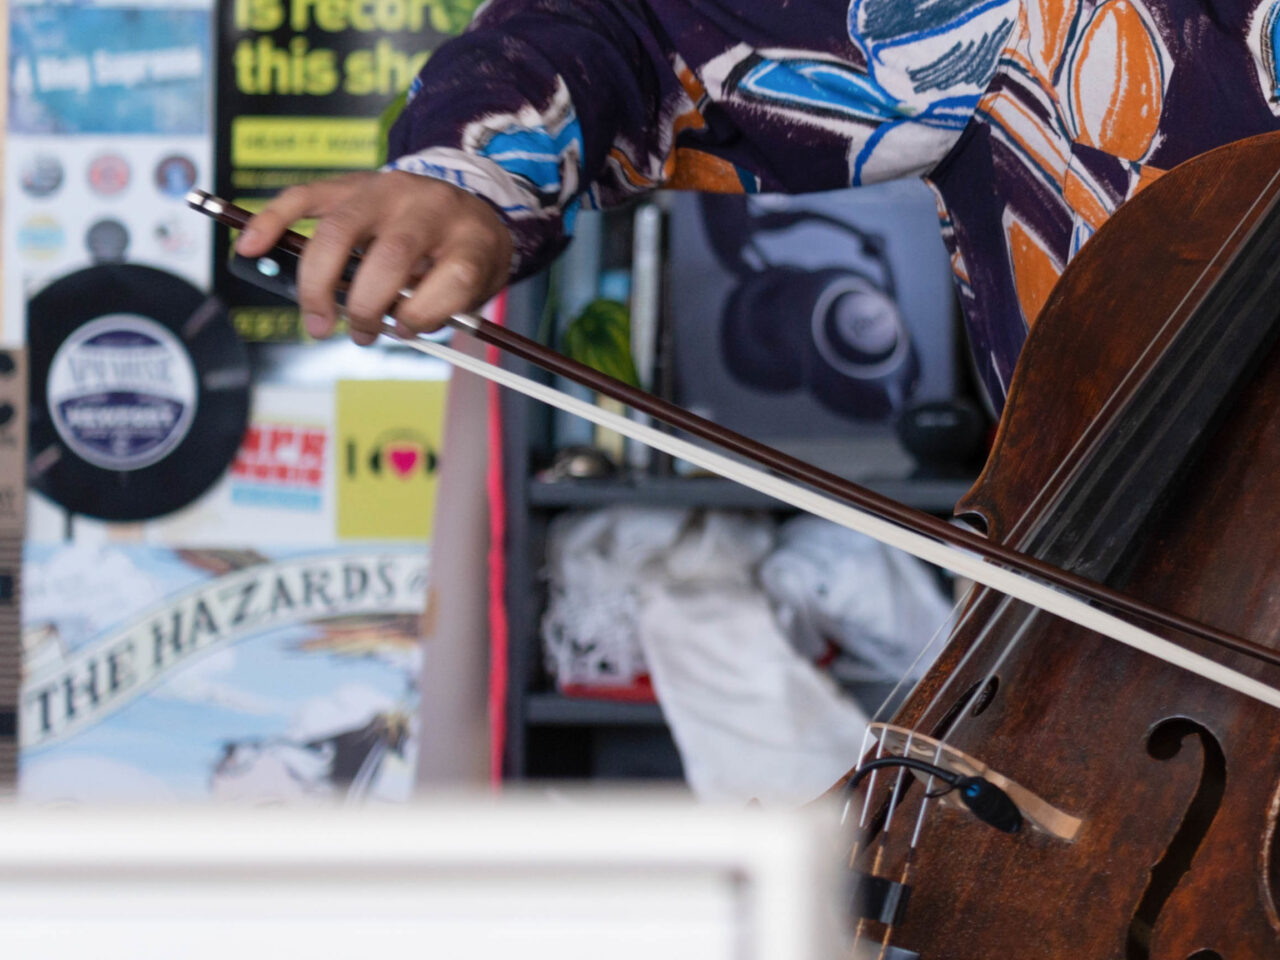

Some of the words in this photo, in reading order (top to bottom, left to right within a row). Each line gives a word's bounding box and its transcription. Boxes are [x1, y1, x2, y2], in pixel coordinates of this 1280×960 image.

[234, 35, 338, 96] this
[25, 641, 136, 734] THE
[150, 562, 395, 669] HAZARDS
